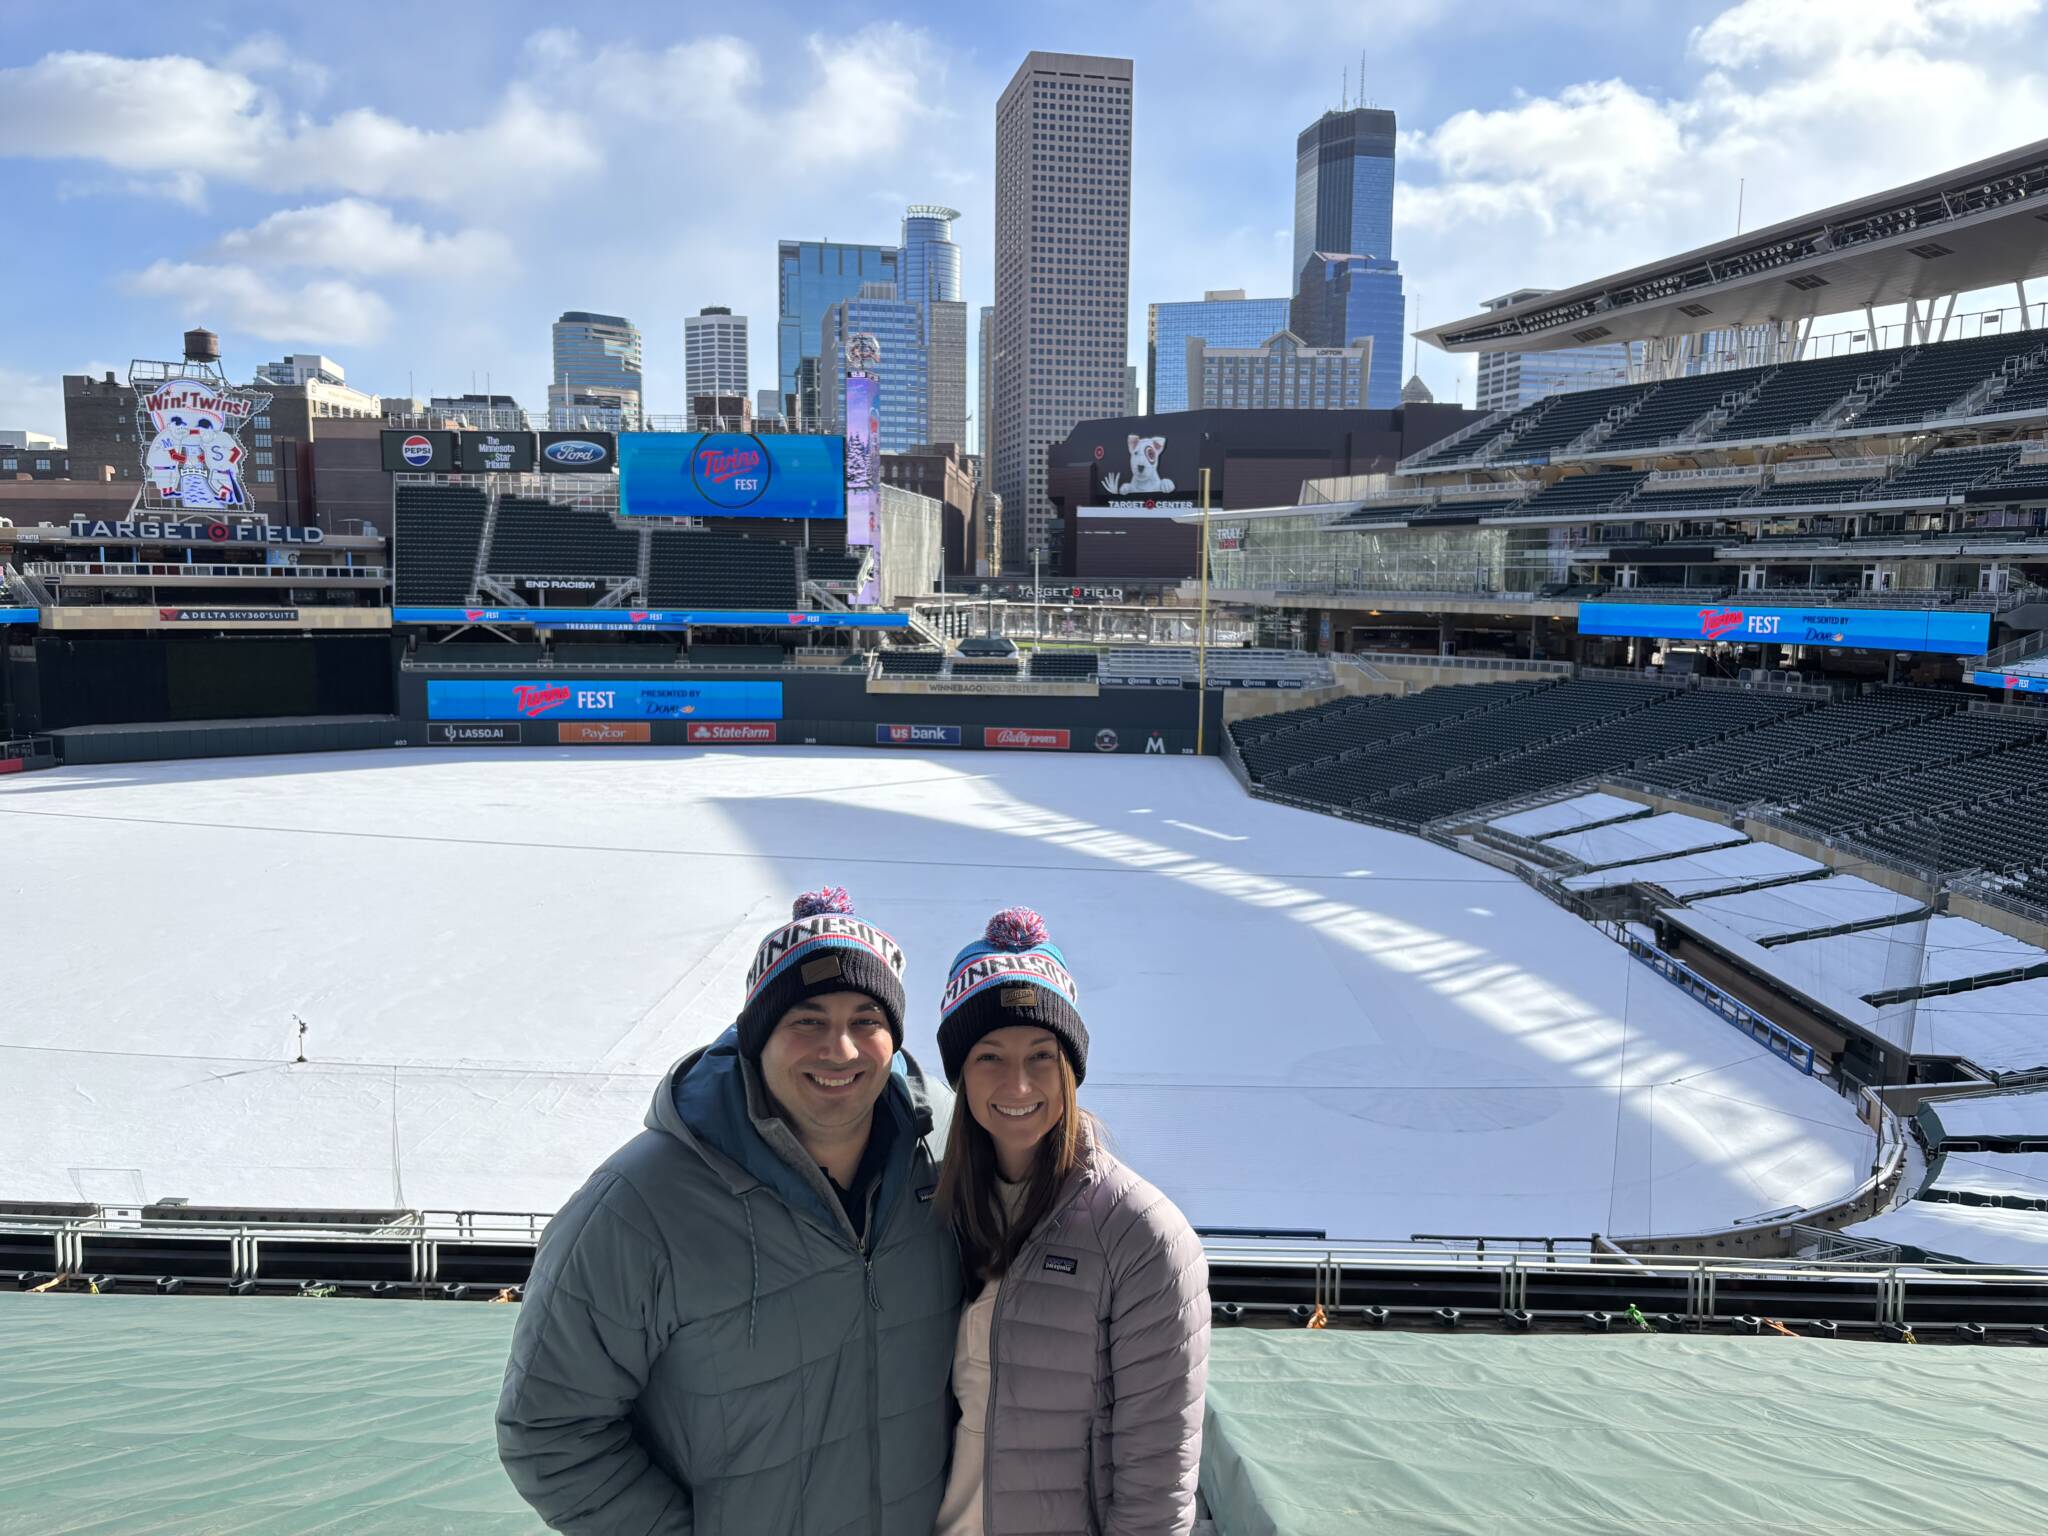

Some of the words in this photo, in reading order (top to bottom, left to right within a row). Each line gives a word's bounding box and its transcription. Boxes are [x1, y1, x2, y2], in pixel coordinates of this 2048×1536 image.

[145, 392, 188, 413] Win!
[190, 392, 251, 417] Twins!
[161, 438, 173, 449] M
[486, 436, 499, 445] The
[211, 445, 224, 462] S
[478, 444, 515, 453] Minnesota
[556, 444, 593, 460] Ford
[495, 453, 510, 462] Star
[485, 461, 510, 469] Tribune
[700, 448, 759, 484] Twins
[735, 479, 758, 491] FEST
[1156, 501, 1193, 509] CENTER
[70, 520, 203, 541] TARGET
[236, 525, 324, 543] FIELD
[525, 580, 550, 589] END
[554, 581, 596, 589] RACISM
[1018, 586, 1070, 598] TARGET
[1083, 588, 1123, 599] FIELD
[192, 611, 227, 619] DELTA
[1802, 615, 1839, 625] PRESENTED
[1840, 616, 1849, 625] BY
[566, 623, 602, 631] TREASURE
[607, 623, 633, 631] ISLAND
[1699, 608, 1744, 639] Twins
[1748, 615, 1781, 634] FEST
[1804, 627, 1832, 641] Dove
[641, 690, 687, 698] PRESENTED
[689, 690, 701, 698] BY
[929, 684, 982, 692] WINNEBAGO
[513, 684, 571, 717] Twins
[577, 691, 615, 708] FEST
[646, 701, 679, 714] Dove
[459, 729, 504, 738] LASSO.AI
[582, 726, 625, 740] Paycor
[891, 729, 908, 739] us
[911, 726, 946, 740] bank
[997, 730, 1031, 746] Bally
[1032, 735, 1056, 744] SPORTS
[1145, 736, 1166, 753] M
[747, 918, 906, 986] MINNESOTA
